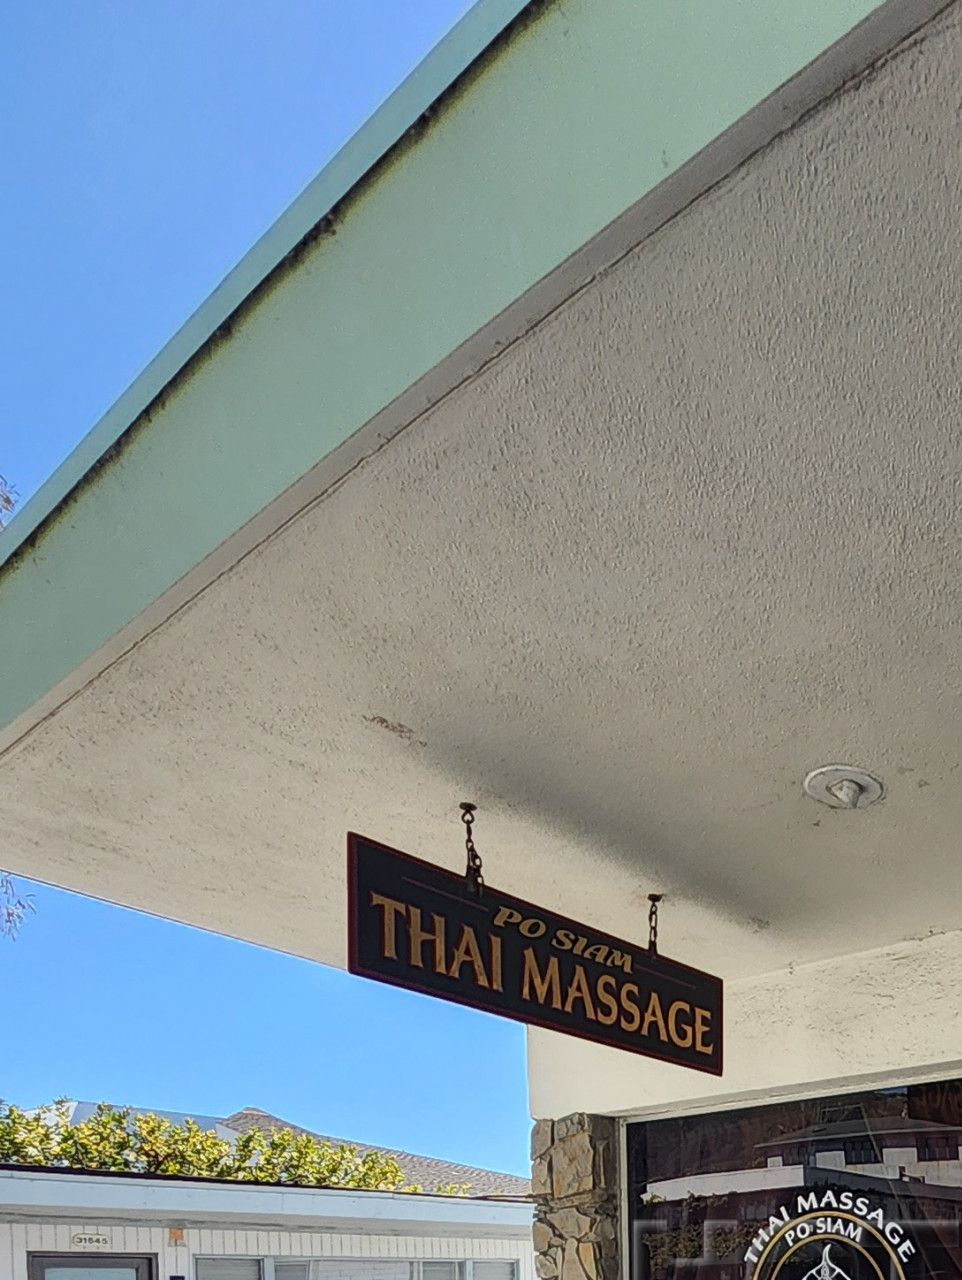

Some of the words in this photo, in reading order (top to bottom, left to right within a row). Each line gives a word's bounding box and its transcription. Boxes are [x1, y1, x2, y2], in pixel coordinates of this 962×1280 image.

[370, 892, 503, 992] THAI
[523, 948, 713, 1054] MASSAGE
[494, 906, 546, 936] PO
[551, 928, 634, 974] SIAM
[75, 1236, 109, 1245] 31645
[744, 1205, 791, 1265] THAI
[796, 1190, 917, 1263] MASSAGE
[784, 1224, 811, 1247] PO
[816, 1217, 864, 1243] SIAM
